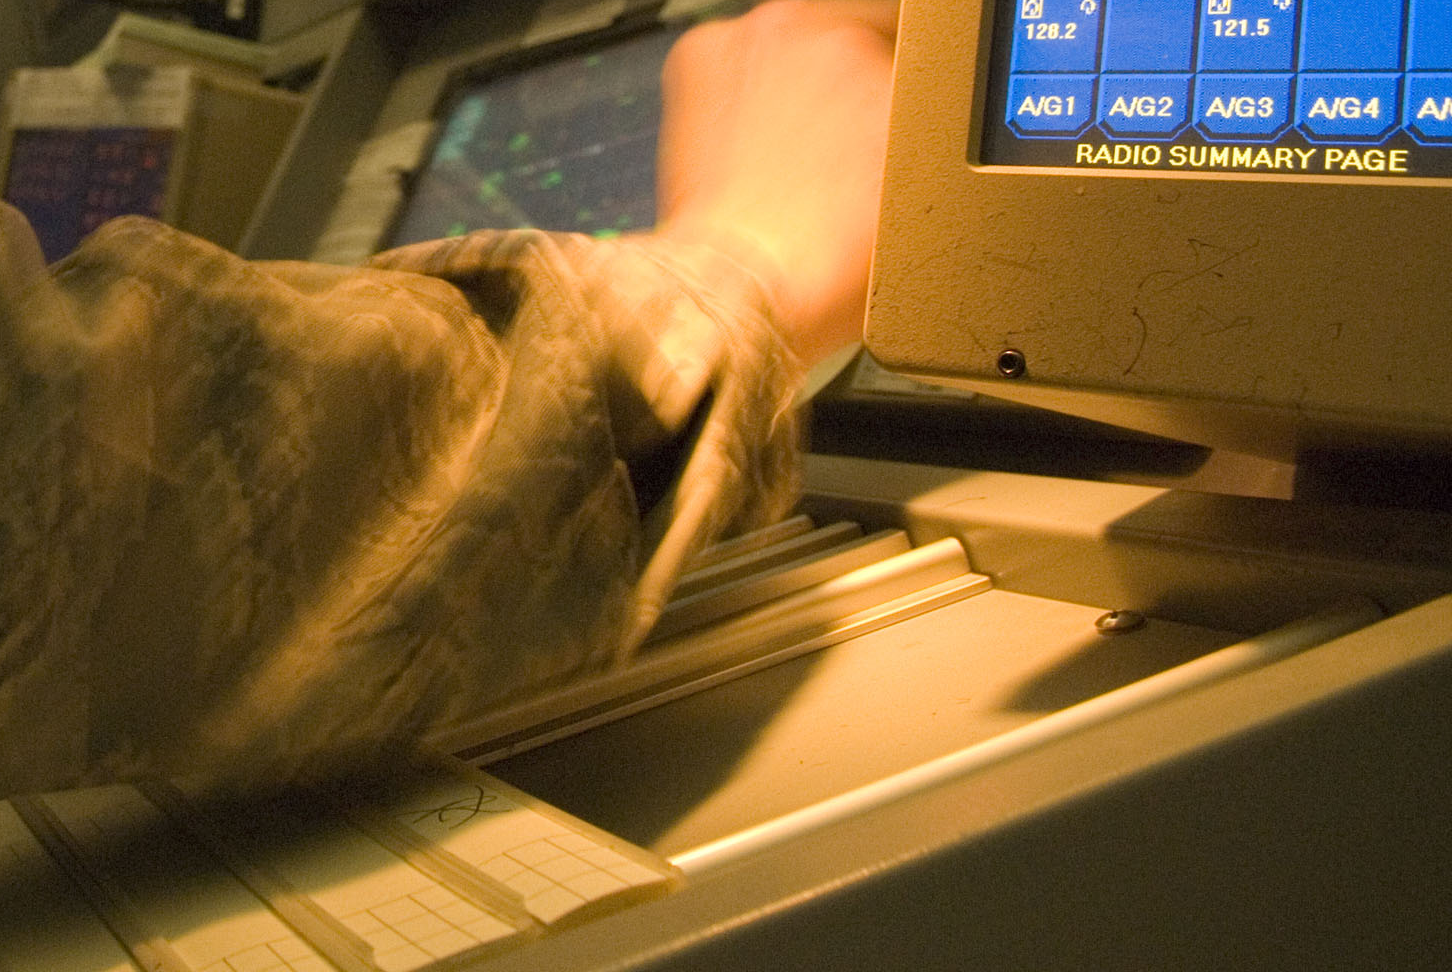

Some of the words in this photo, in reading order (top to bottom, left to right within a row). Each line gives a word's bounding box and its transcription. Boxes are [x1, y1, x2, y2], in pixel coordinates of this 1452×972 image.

[1213, 19, 1269, 36] 121.5
[1018, 96, 1075, 116] A/G1
[1109, 96, 1173, 117] A/G2
[1206, 97, 1273, 118] A/G3
[1308, 97, 1379, 119] A/G4
[1417, 98, 1452, 120] A/
[1076, 143, 1161, 166] RADIO
[1169, 145, 1316, 170] SUMMARY
[1324, 148, 1409, 172] PAGE
